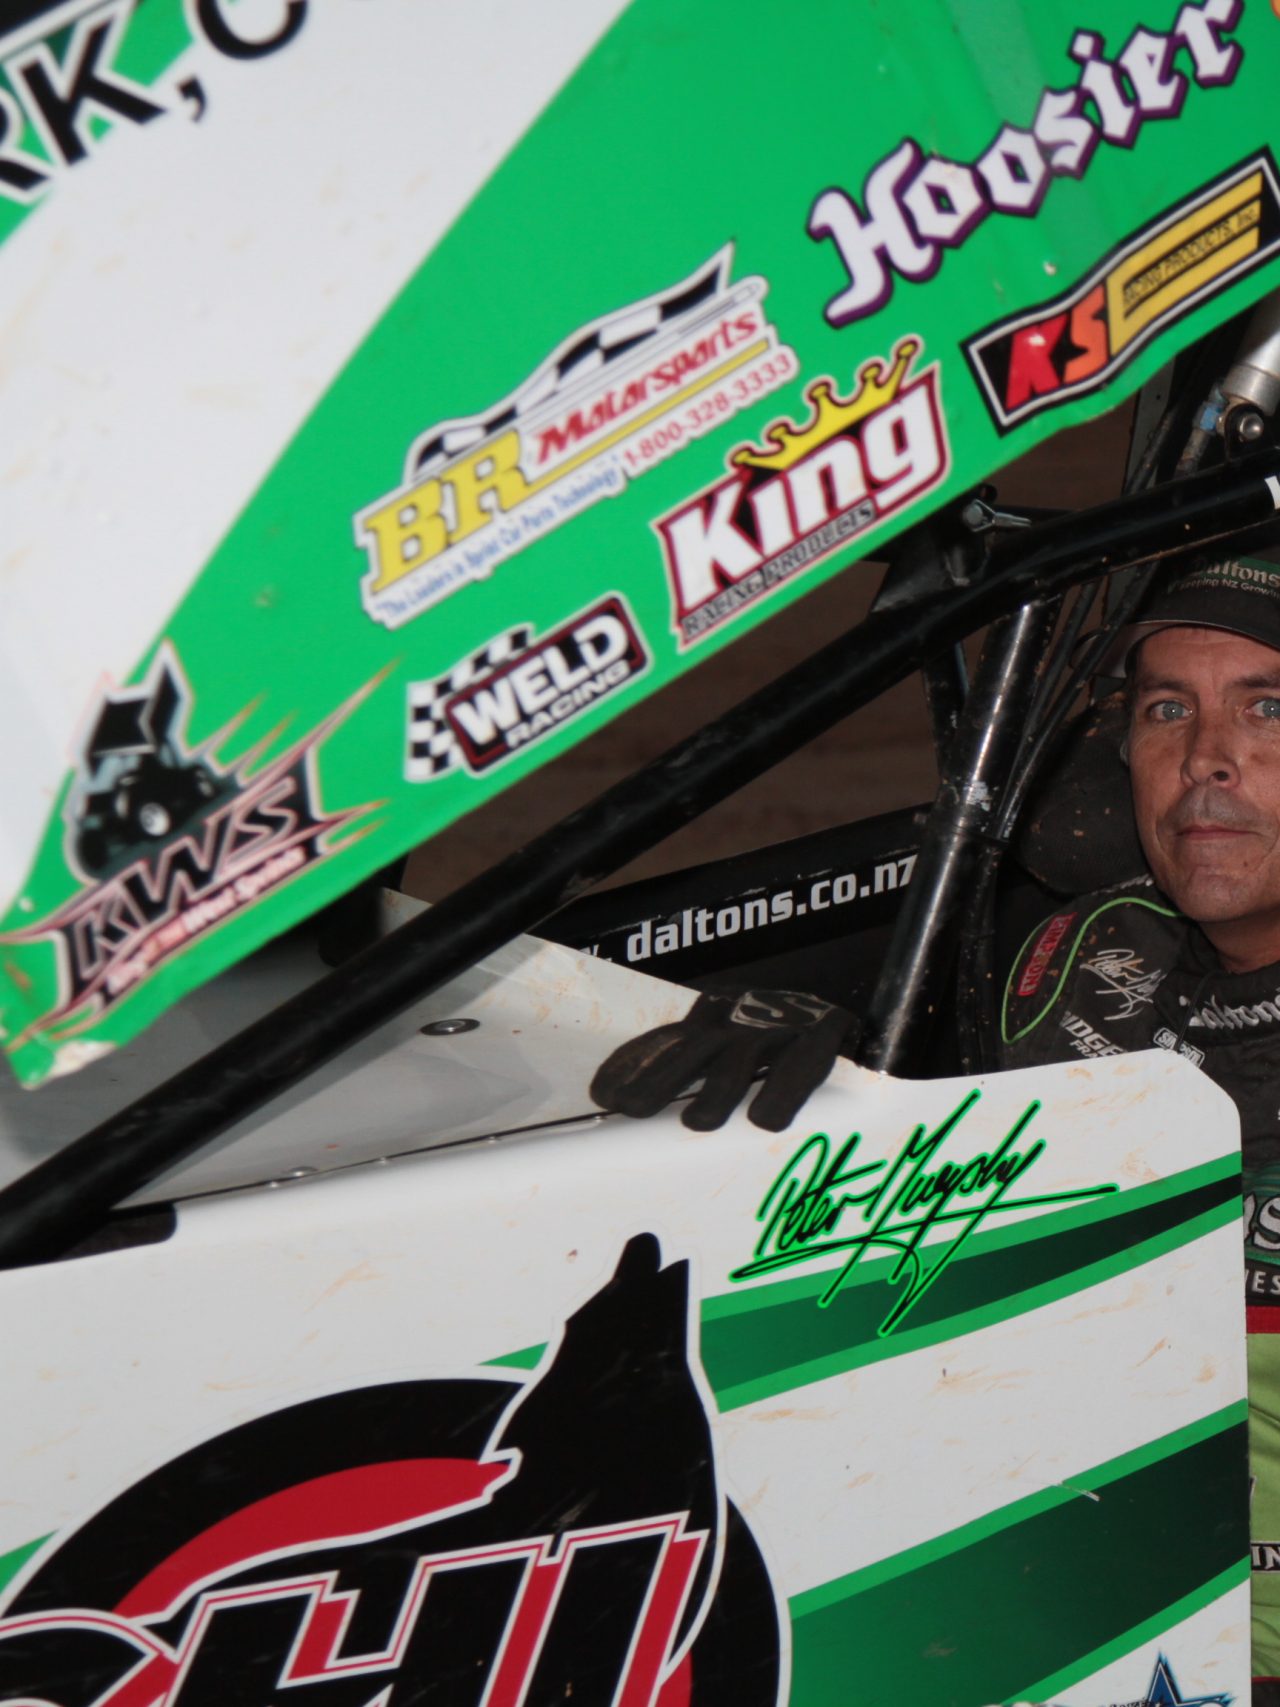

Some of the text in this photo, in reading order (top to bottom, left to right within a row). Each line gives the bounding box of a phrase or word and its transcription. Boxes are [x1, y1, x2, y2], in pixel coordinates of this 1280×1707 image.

[806, 0, 1244, 328] Hoosier
[536, 311, 758, 464] Motorsports
[363, 428, 530, 595] BR
[662, 376, 943, 614] King
[452, 614, 630, 746] WELD
[505, 659, 631, 749] RACING
